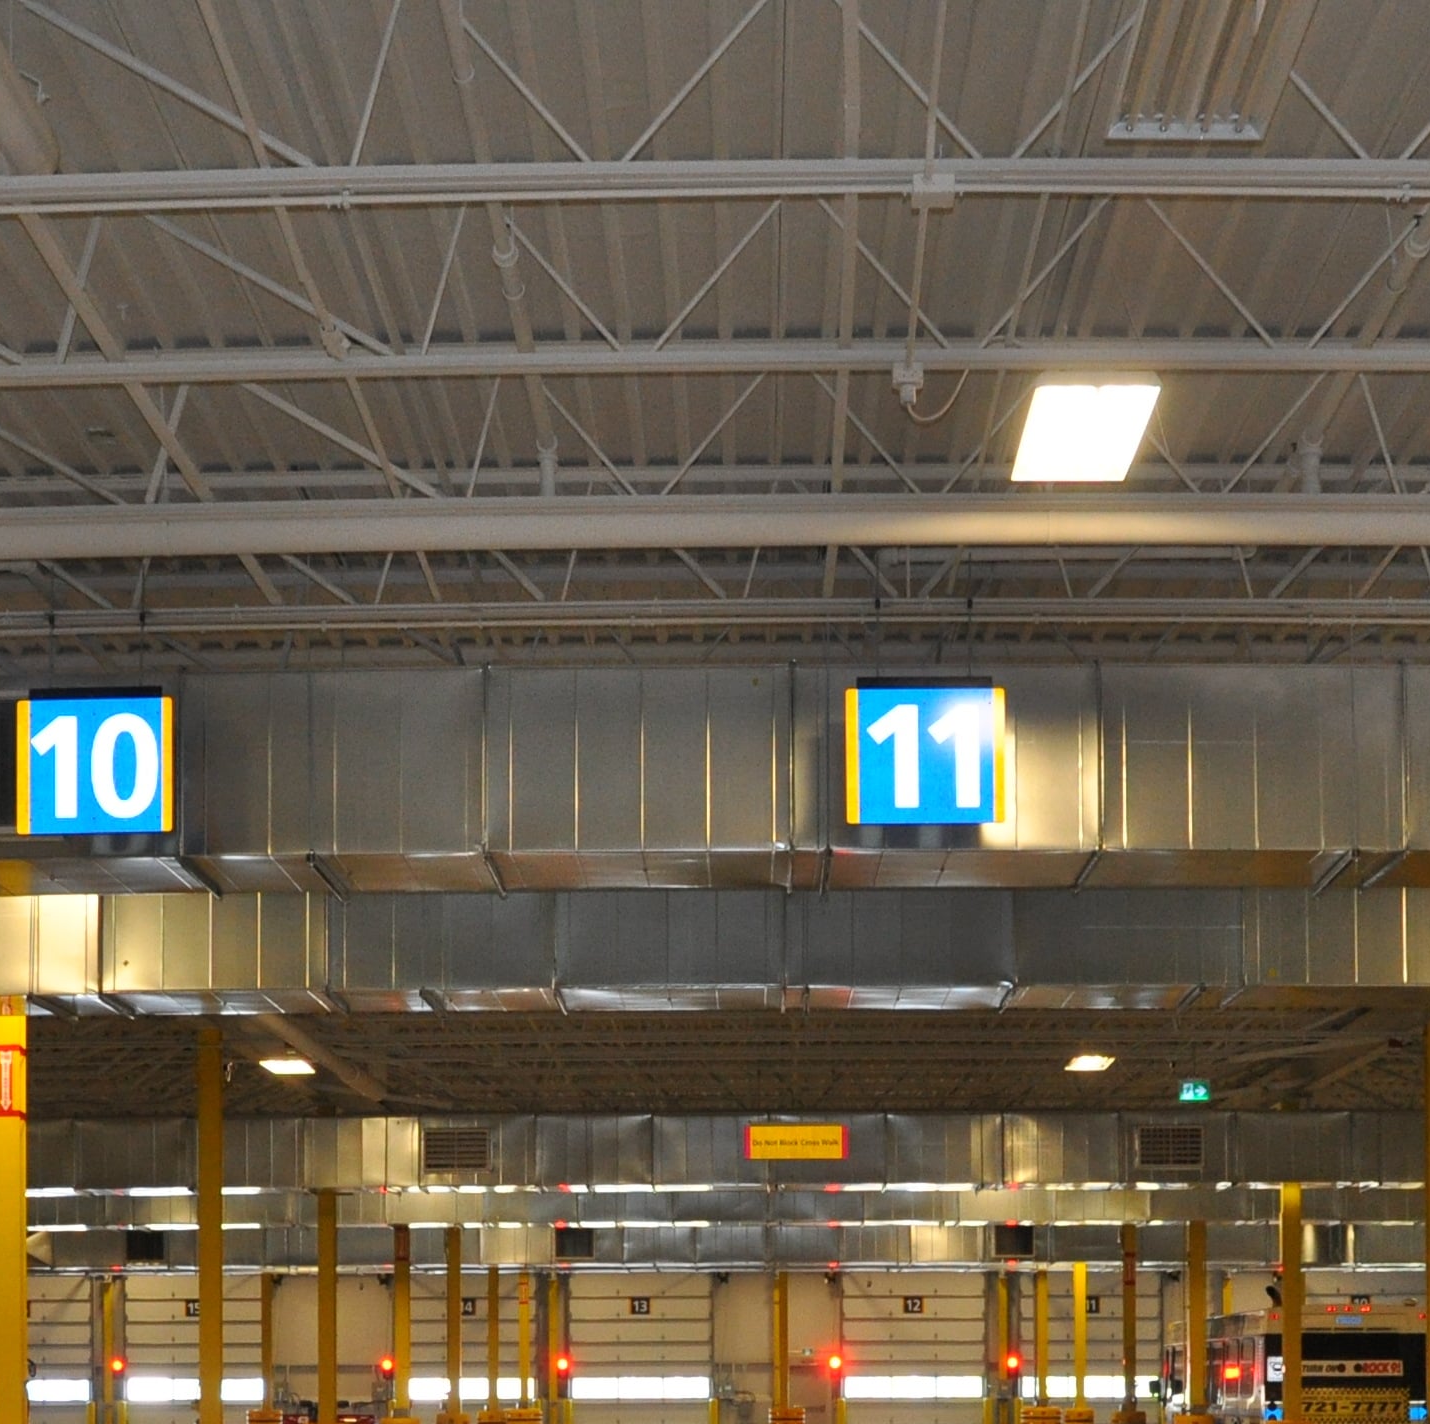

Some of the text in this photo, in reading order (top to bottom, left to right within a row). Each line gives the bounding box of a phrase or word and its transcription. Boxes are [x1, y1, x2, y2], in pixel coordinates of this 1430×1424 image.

[866, 704, 980, 808] 11
[30, 712, 159, 819] 10
[633, 1300, 648, 1312] 13
[906, 1299, 921, 1311] 12
[1362, 1363, 1390, 1374] ROCK
[1302, 1401, 1402, 1413] 721-7777
